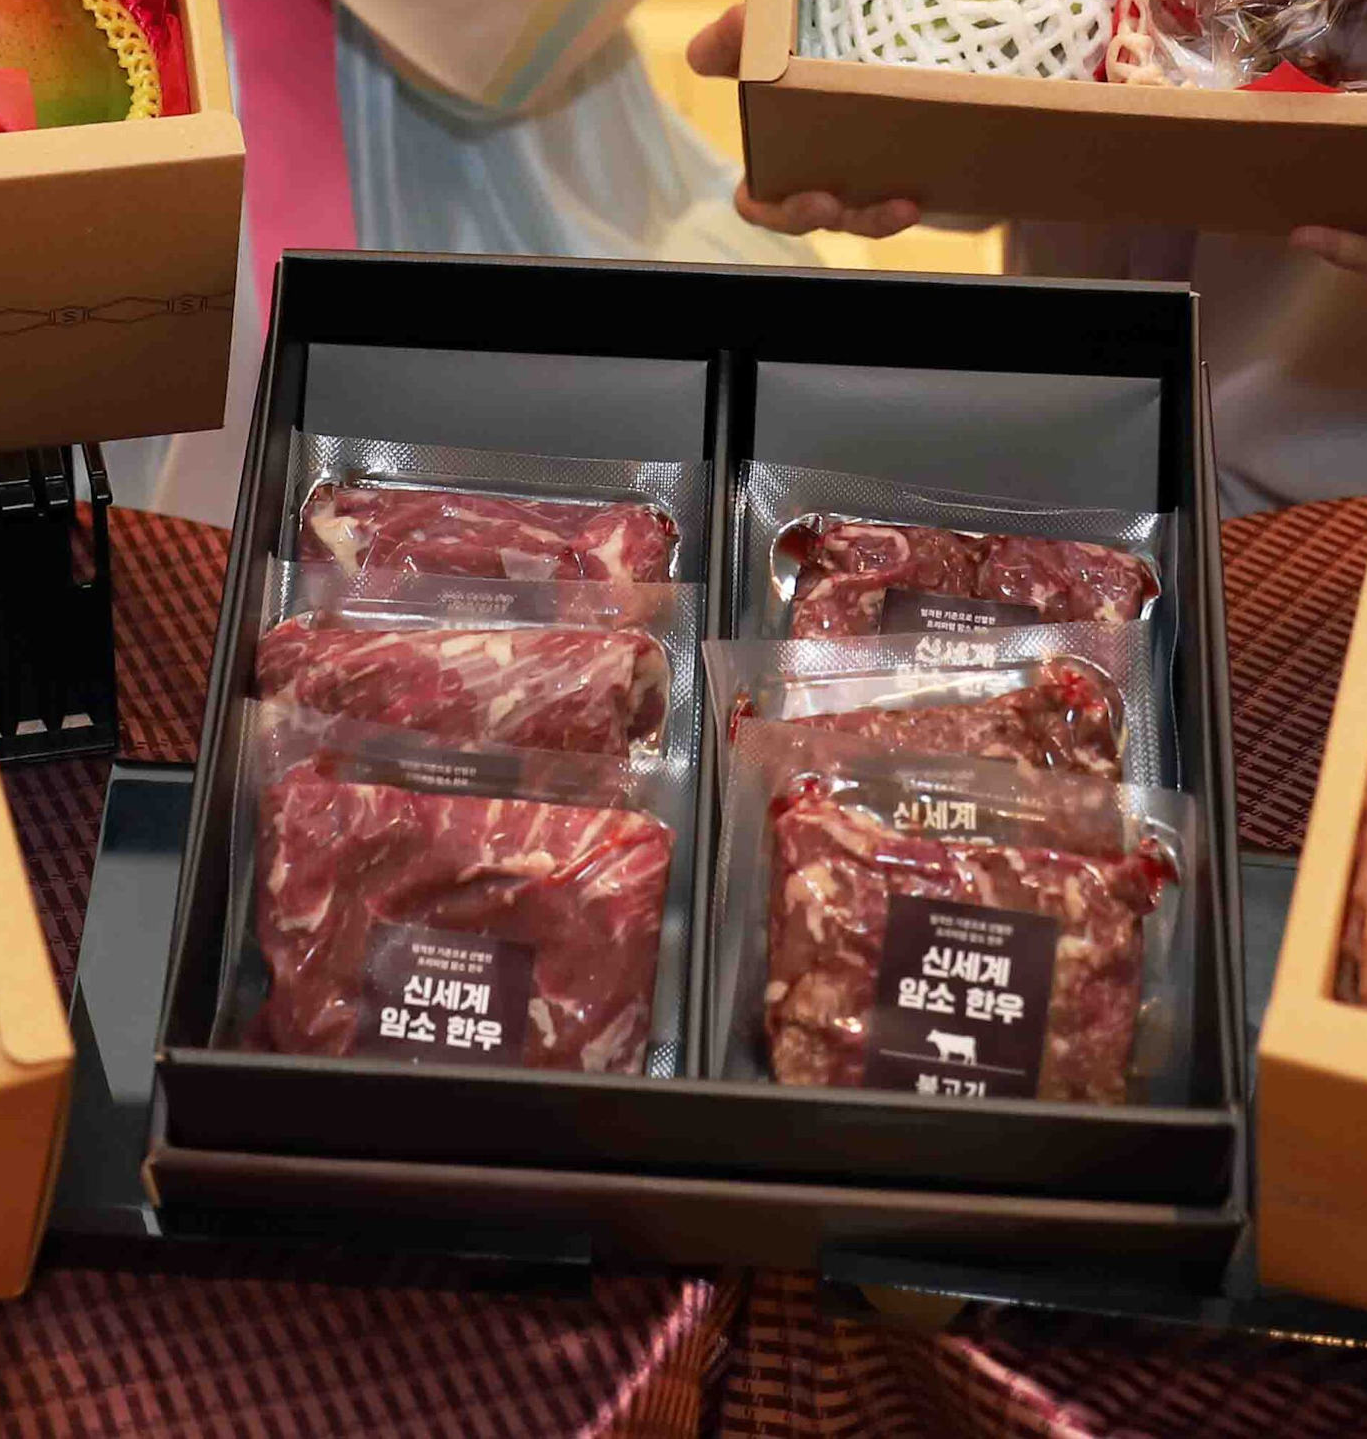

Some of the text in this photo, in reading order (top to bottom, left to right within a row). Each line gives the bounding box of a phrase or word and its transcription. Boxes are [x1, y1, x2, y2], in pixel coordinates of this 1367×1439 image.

[893, 800, 978, 831] 신세계
[921, 946, 1011, 987] 신세계
[403, 974, 491, 1015] 신세계
[897, 977, 1025, 1025] 암소 한우
[380, 1006, 503, 1052] 암소 한우
